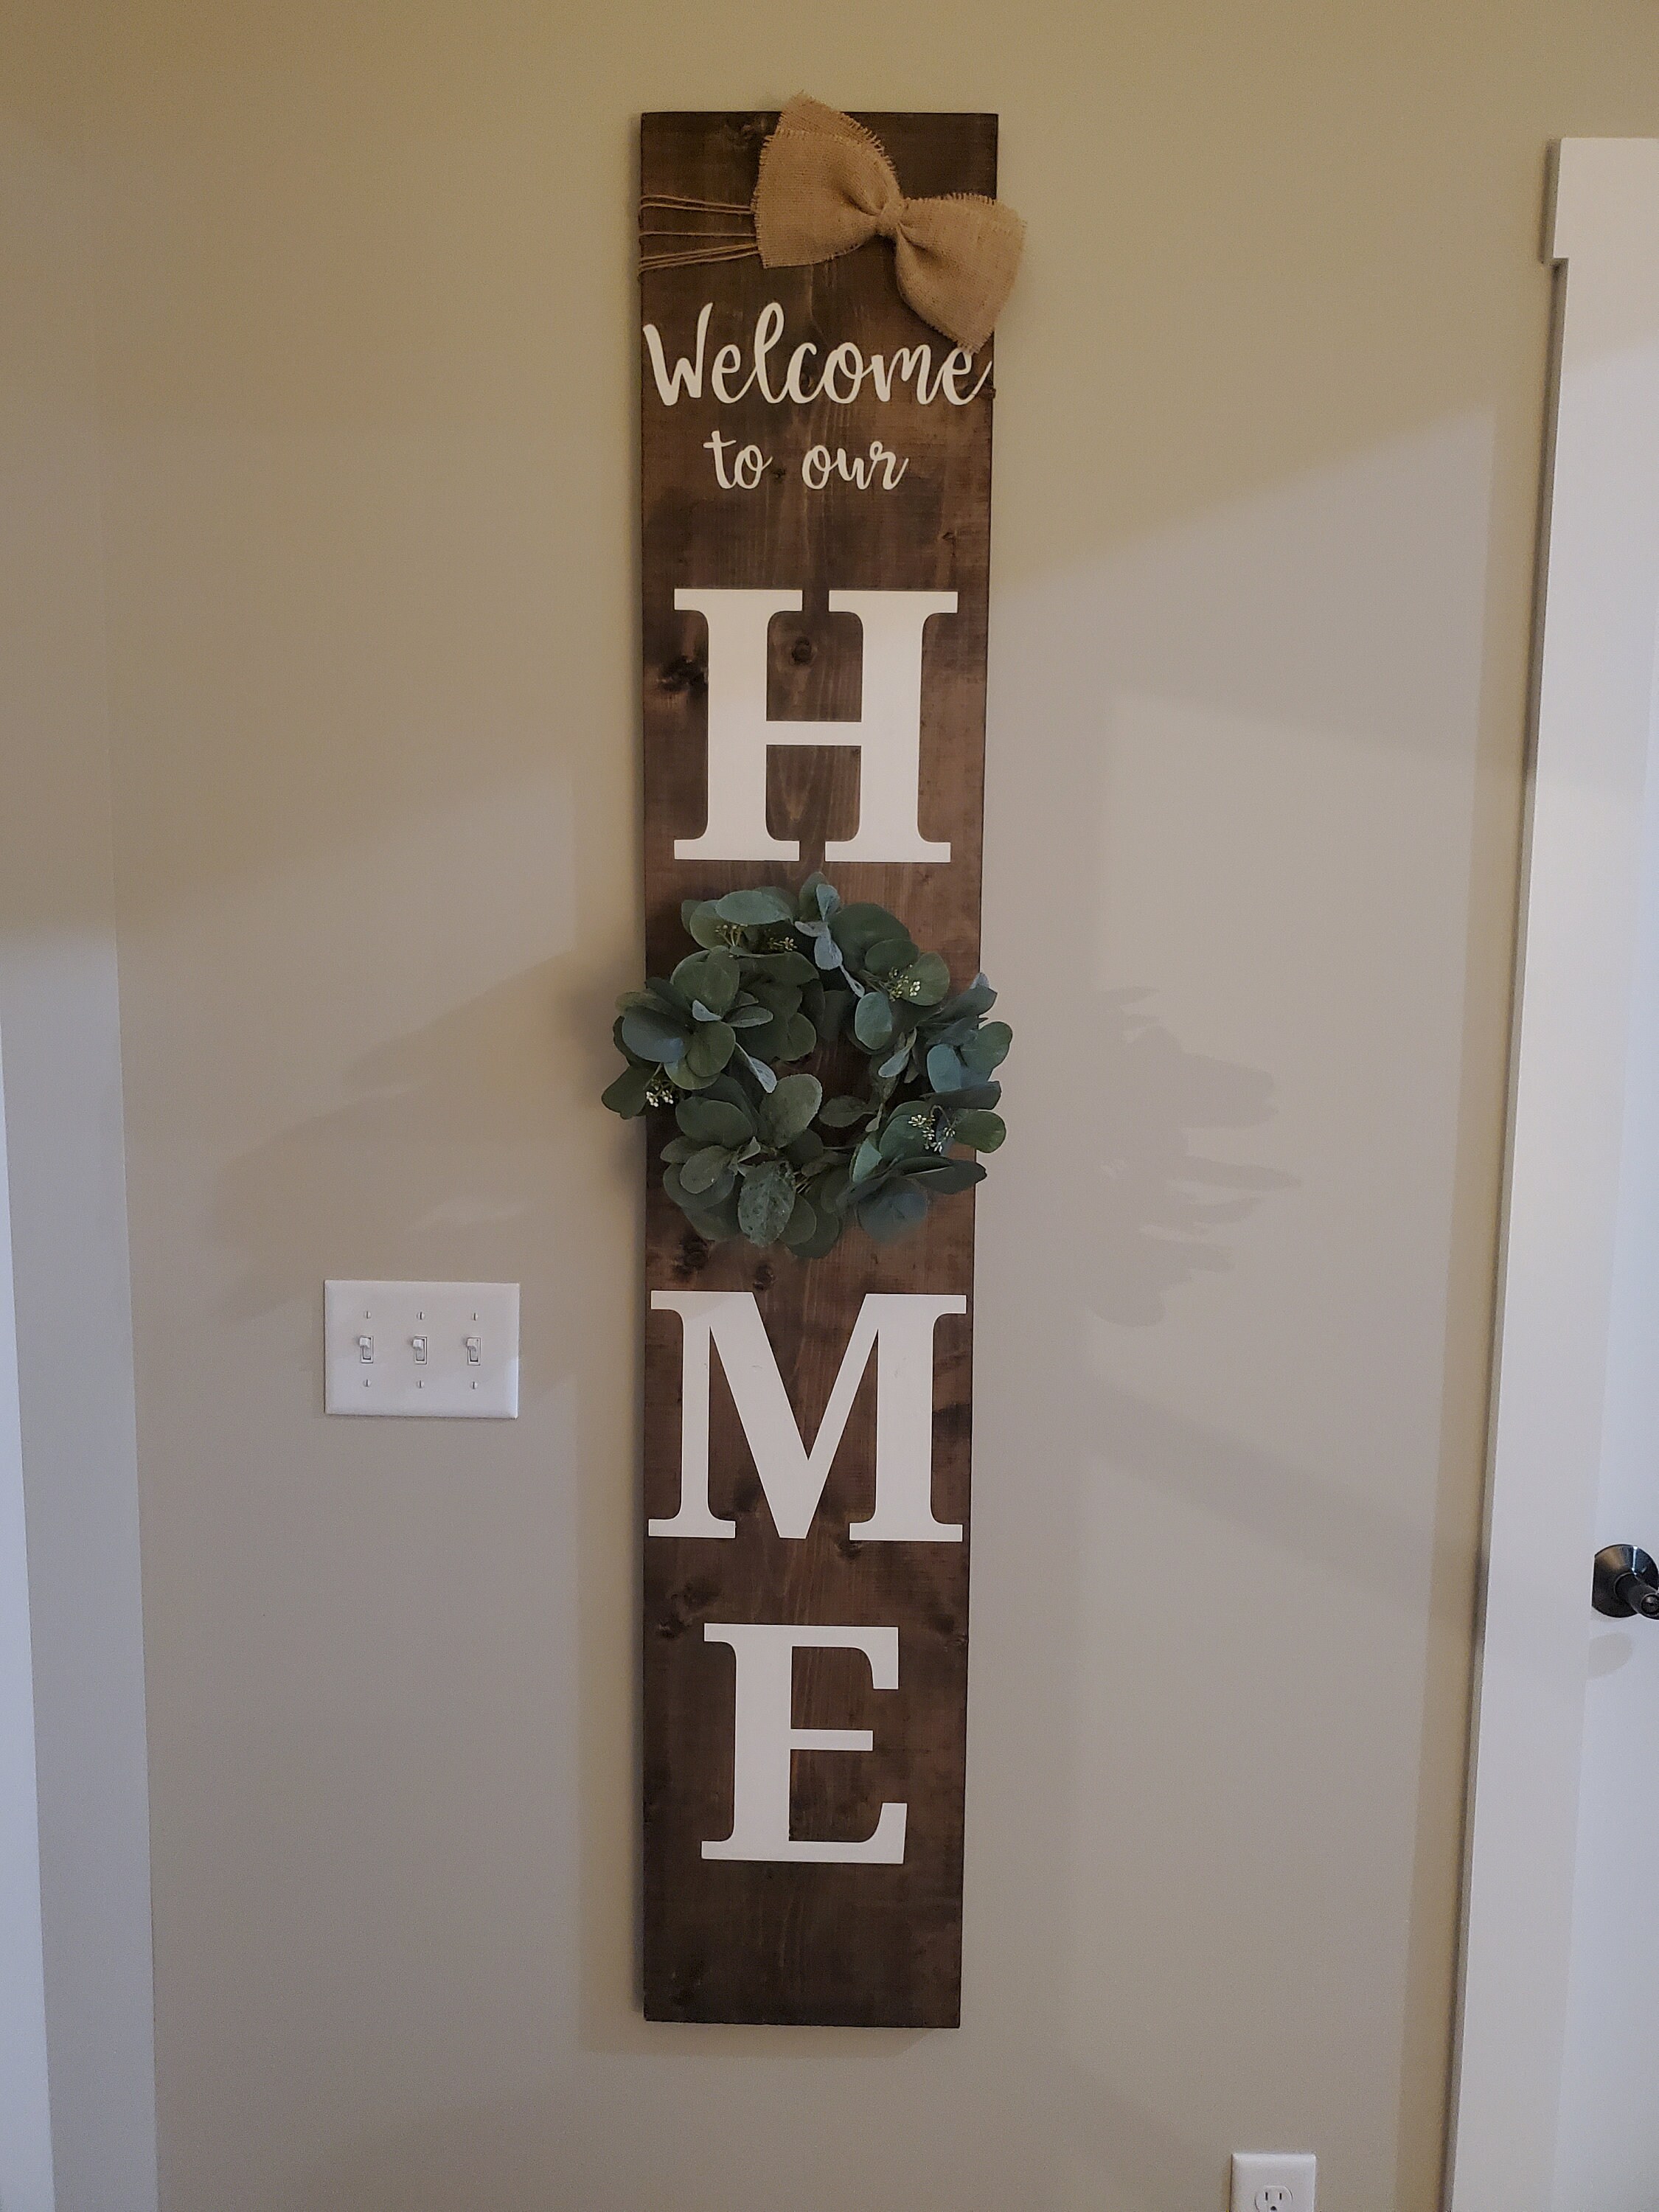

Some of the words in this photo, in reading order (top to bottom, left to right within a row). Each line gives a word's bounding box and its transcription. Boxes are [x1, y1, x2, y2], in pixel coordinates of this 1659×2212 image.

[643, 302, 992, 406] Welcome
[703, 430, 773, 490] to
[801, 441, 909, 490] our
